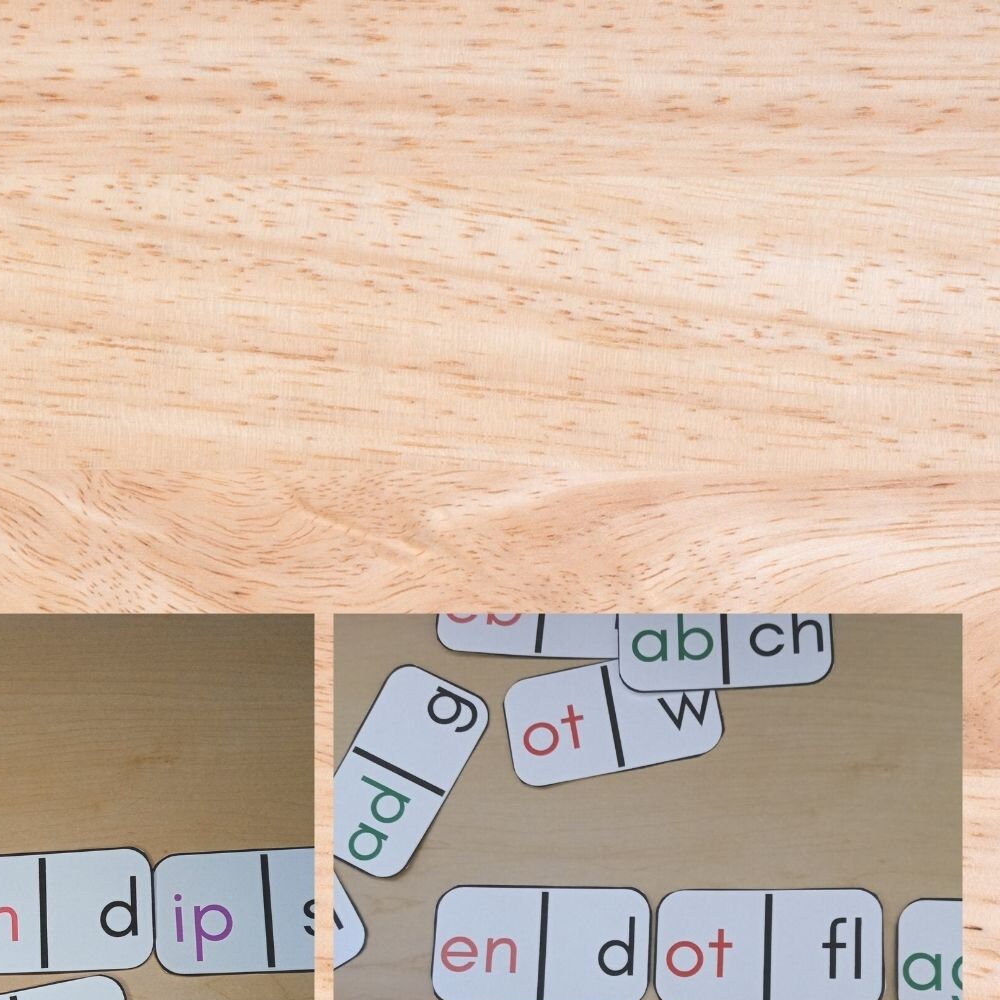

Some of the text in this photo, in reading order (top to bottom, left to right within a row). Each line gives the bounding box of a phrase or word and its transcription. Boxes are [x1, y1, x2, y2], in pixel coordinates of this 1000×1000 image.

[631, 613, 824, 662] ab ch
[522, 690, 711, 757] ot w
[348, 686, 478, 861] ad g
[99, 875, 139, 938] d
[173, 893, 234, 962] ip
[441, 916, 636, 977] en d
[665, 917, 862, 980] ot fl
